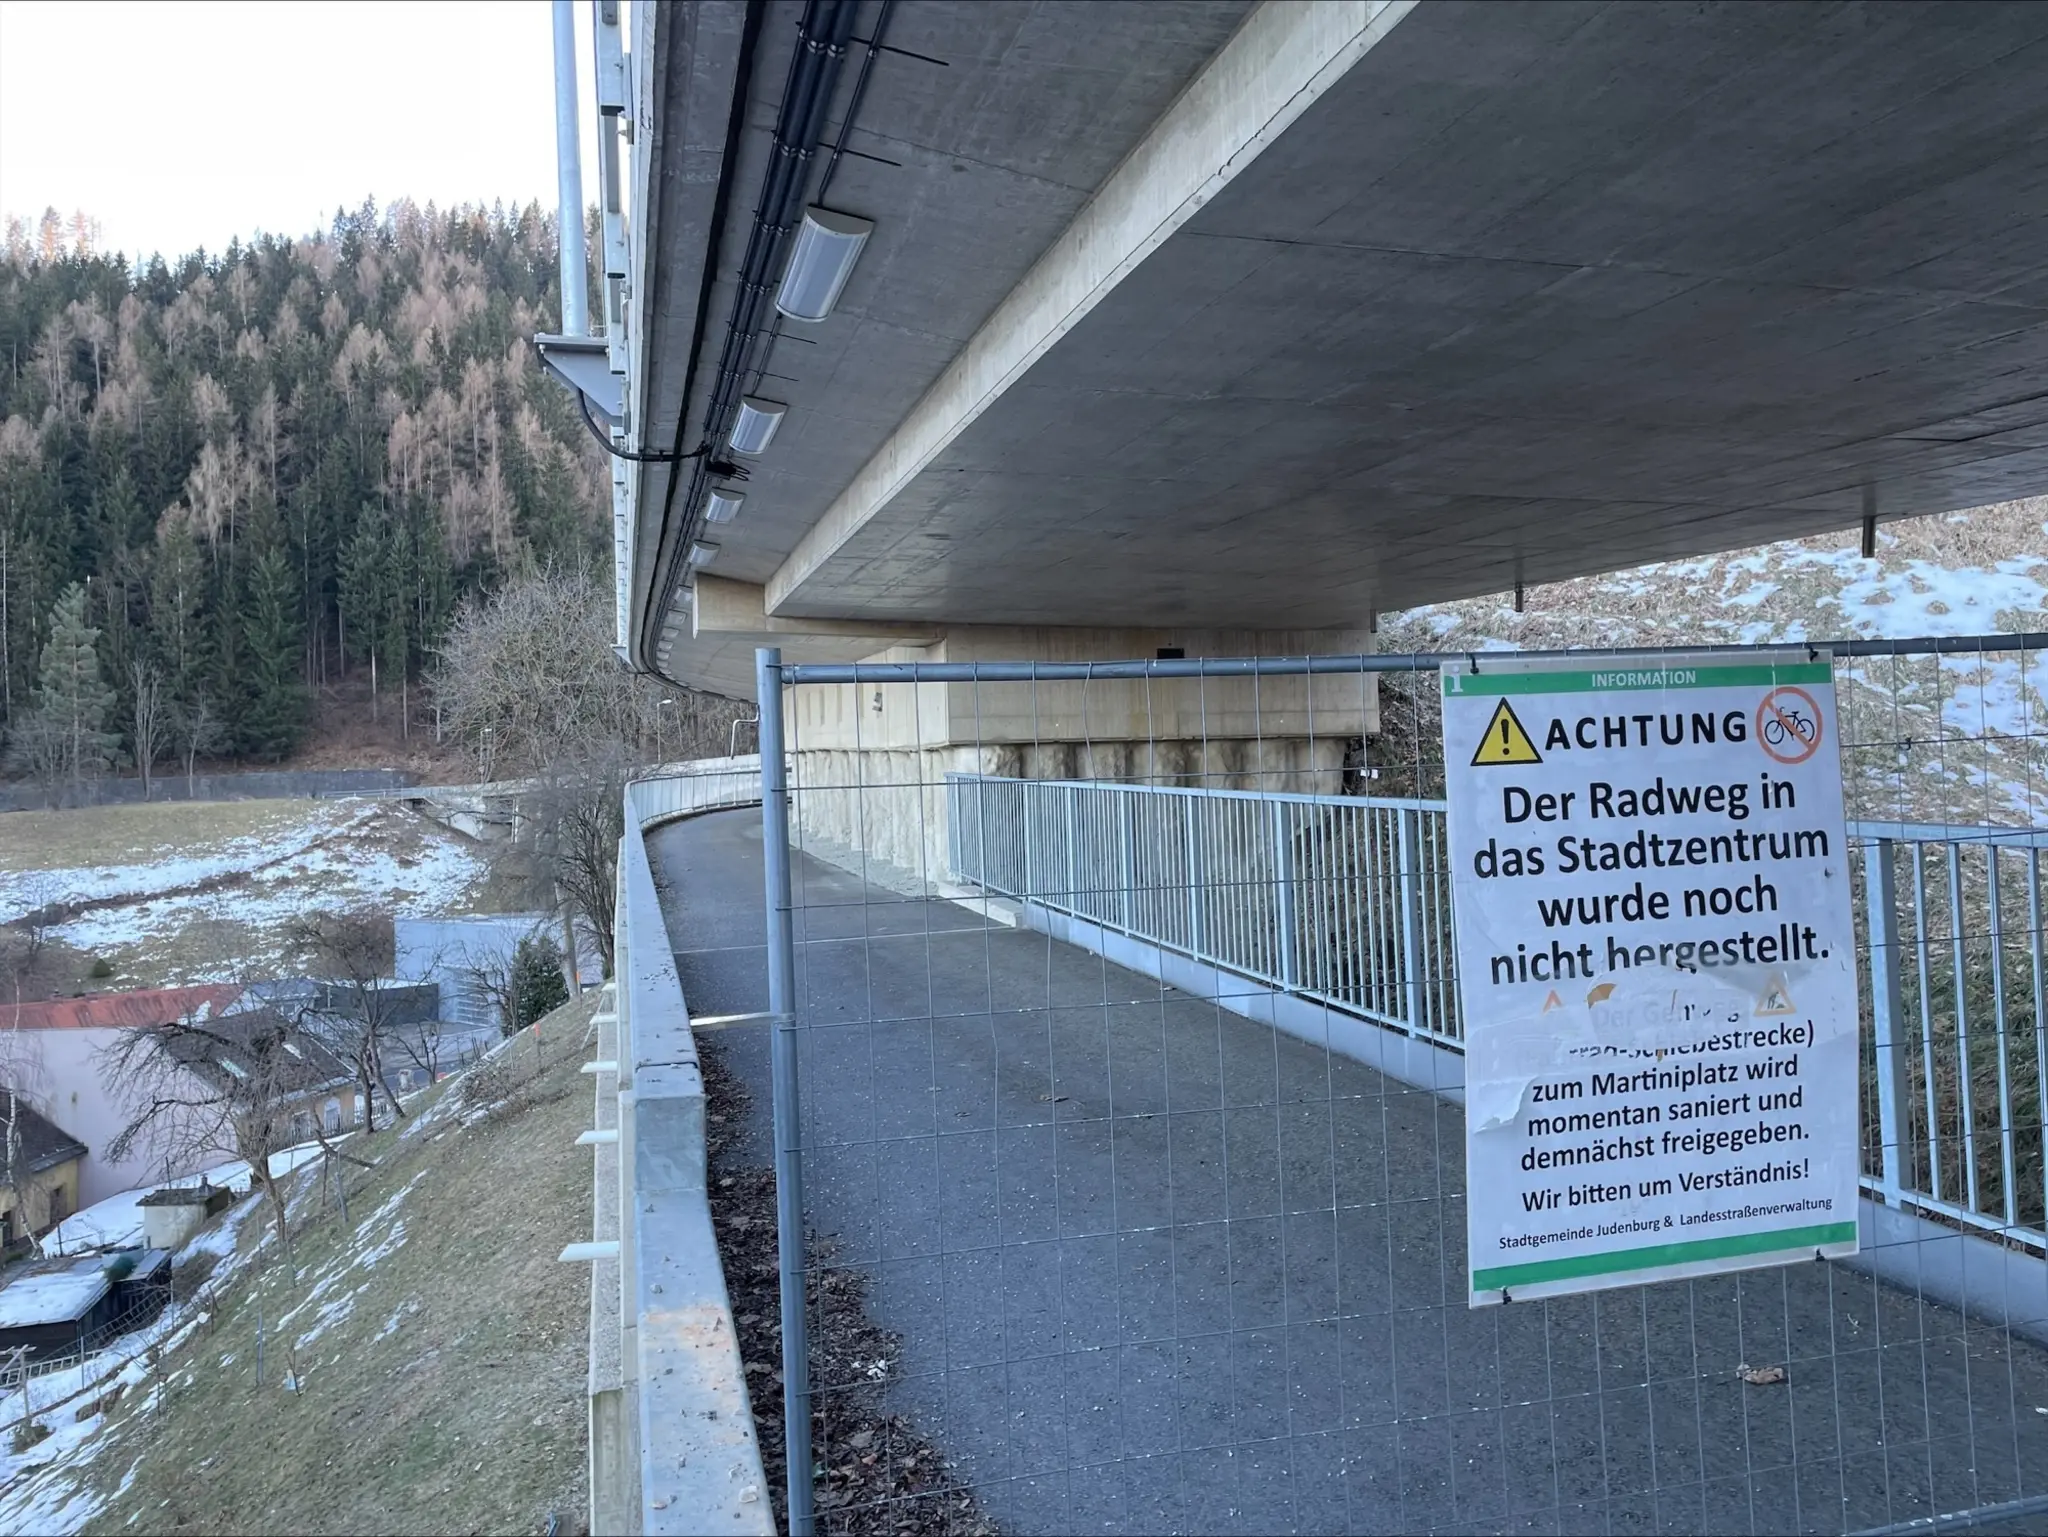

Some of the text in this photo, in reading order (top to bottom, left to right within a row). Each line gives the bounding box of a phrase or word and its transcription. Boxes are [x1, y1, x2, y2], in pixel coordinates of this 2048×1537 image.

[1591, 670, 1697, 688] INFORMATION
[1544, 711, 1747, 752] ACHTUNG
[1502, 772, 1796, 824] Der Radweg in
[1473, 829, 1829, 879] das Stadtzentrum
[1537, 873, 1778, 928] wurde noch
[1490, 922, 1829, 985] nicht hergestellt.
[1532, 1054, 1798, 1103] zum Martiniplatz wird
[1528, 1084, 1803, 1137] momentan saniert und
[1520, 1120, 1810, 1172] demnächst freigegeben.
[1521, 1157, 1810, 1213] Wir bitten um Verständnis!
[1499, 1197, 1833, 1250] Stadtgemeinde Judenburg & Landesstraßenverwaltung
